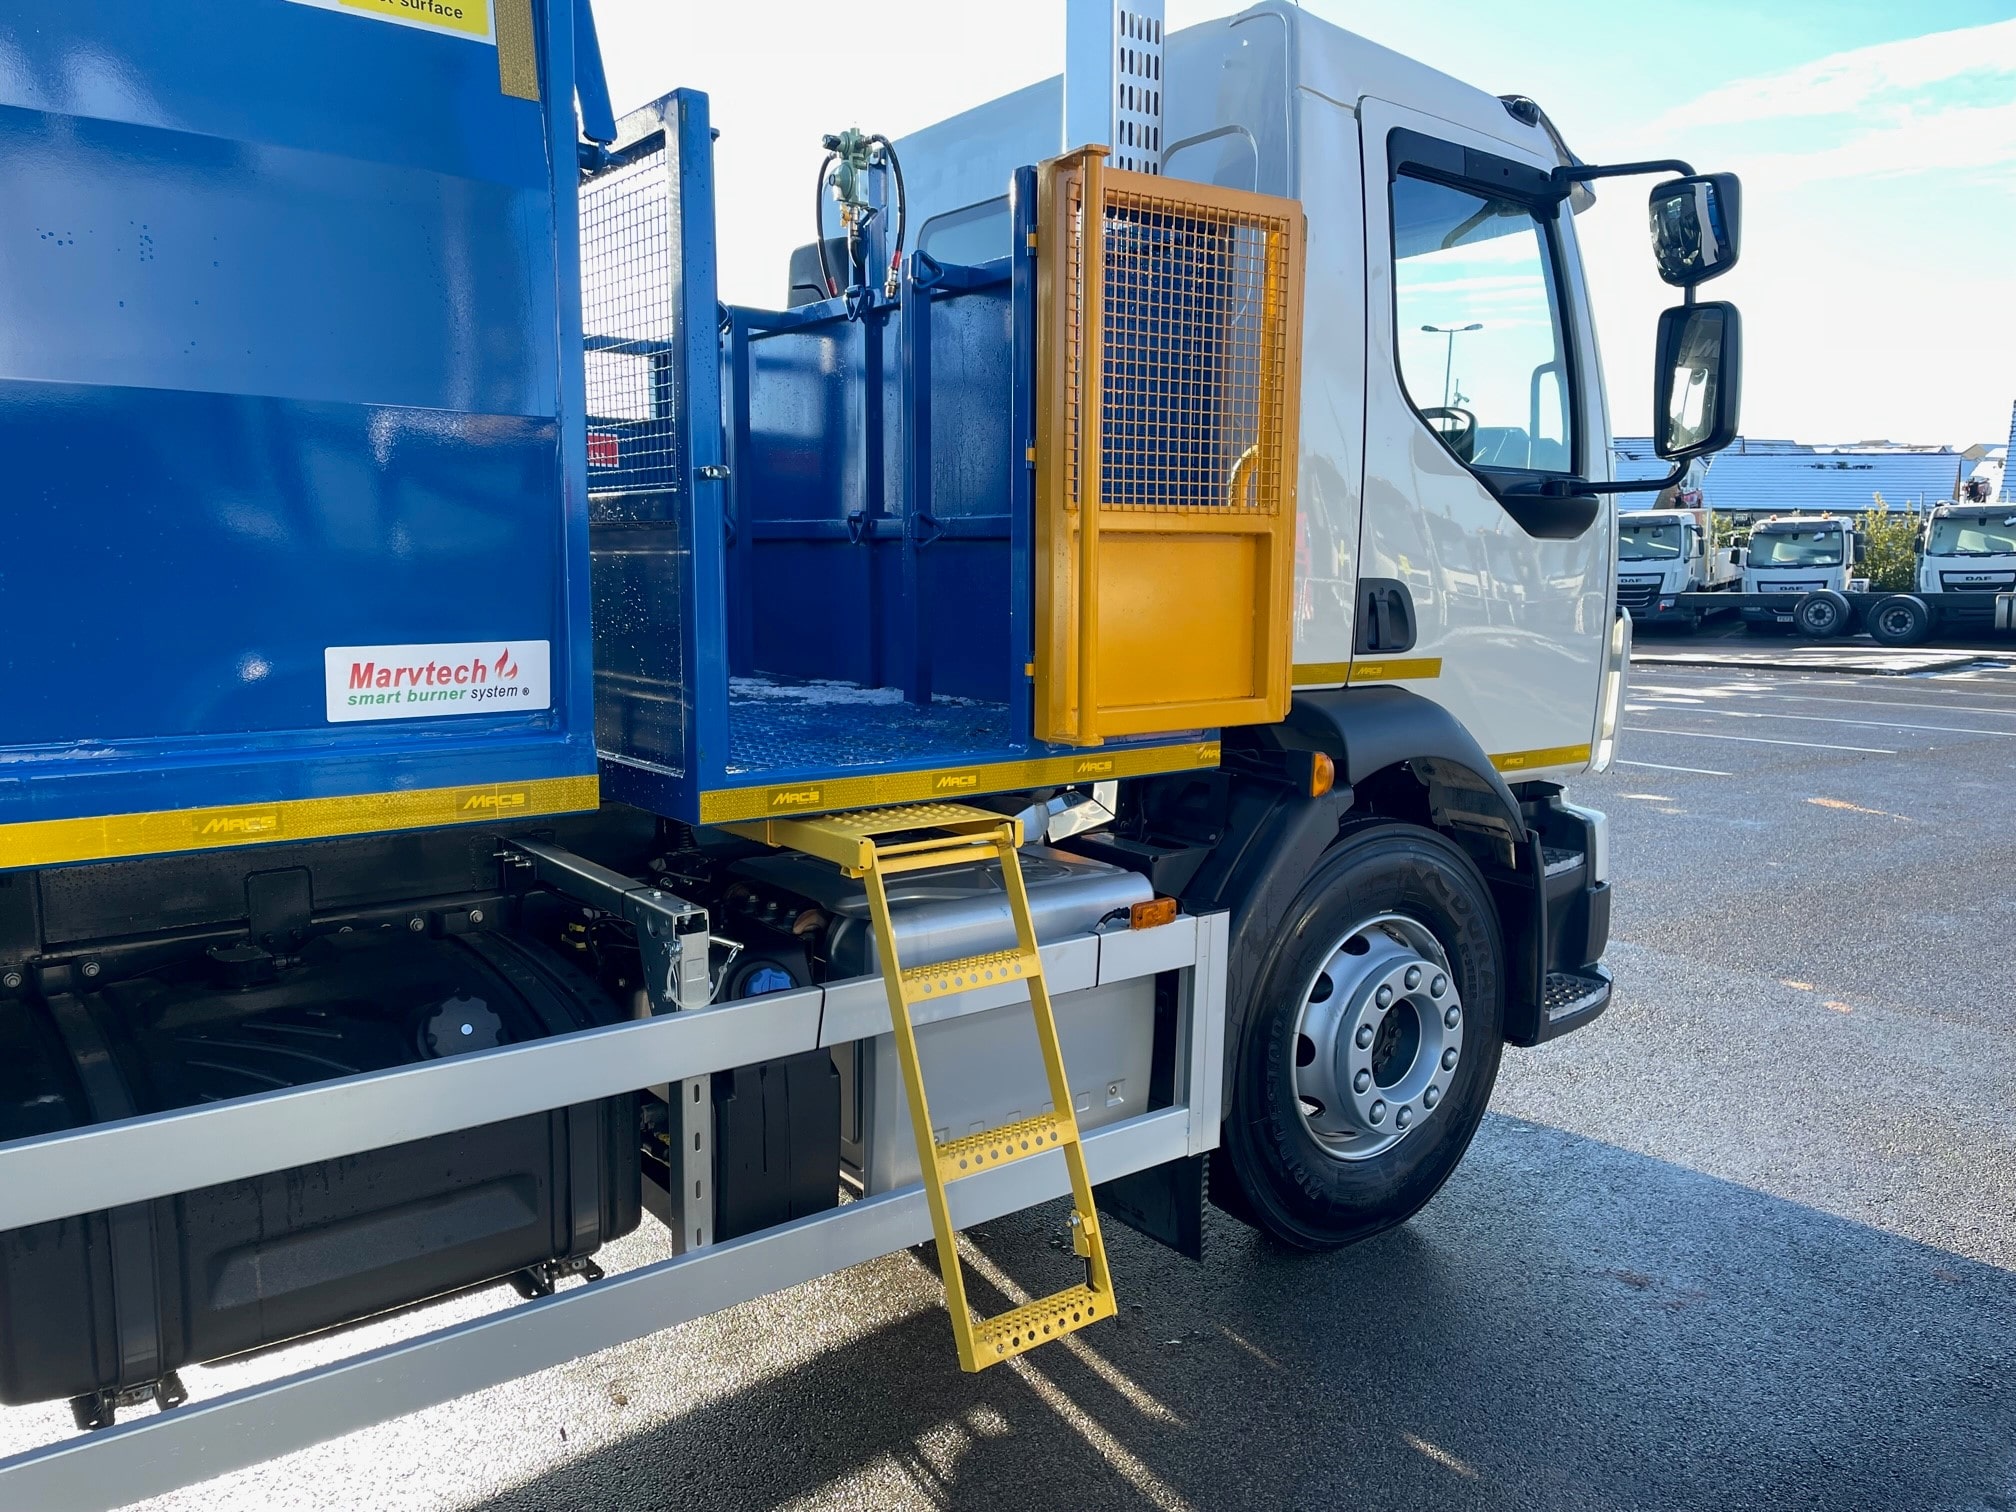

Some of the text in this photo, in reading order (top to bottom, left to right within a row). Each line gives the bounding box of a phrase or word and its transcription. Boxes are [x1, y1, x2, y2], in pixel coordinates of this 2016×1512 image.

[349, 659, 487, 689] Marvtech
[1358, 667, 1382, 675] MACS
[347, 691, 401, 706] smart
[407, 688, 467, 703] burner
[470, 686, 518, 702] system
[1077, 761, 1112, 773] MACS
[936, 775, 976, 788] MACS
[463, 793, 524, 809] MACS
[772, 791, 819, 806] MACS
[201, 815, 277, 834] MACS
